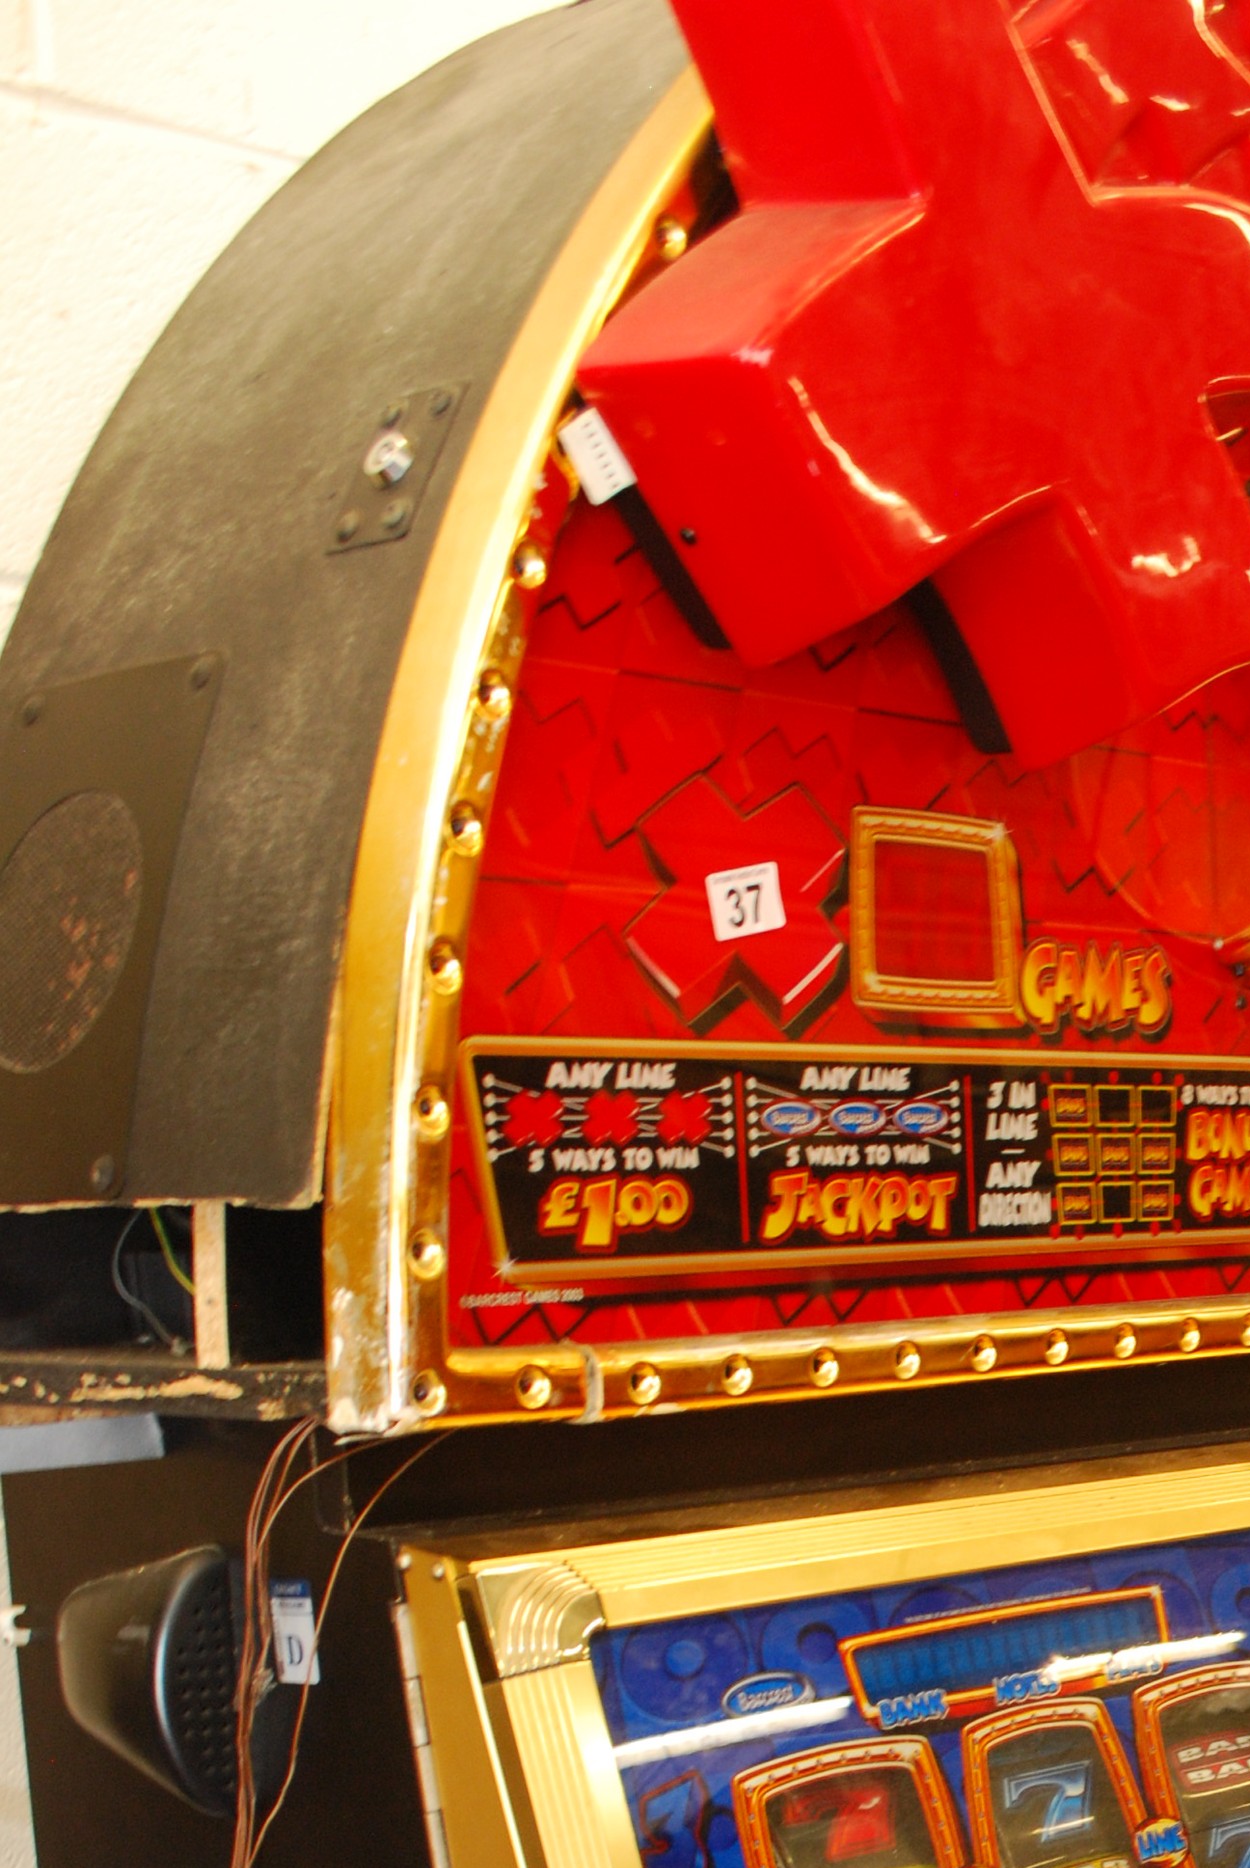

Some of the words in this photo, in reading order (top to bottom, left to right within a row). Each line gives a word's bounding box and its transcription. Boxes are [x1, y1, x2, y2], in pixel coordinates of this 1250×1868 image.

[727, 884, 761, 927] 37
[1024, 942, 1170, 1028] GAMES
[546, 1062, 609, 1088] ANY
[615, 1063, 677, 1089] LINE
[801, 1067, 853, 1091] ANY
[858, 1067, 911, 1091] LINE
[987, 1081, 1005, 1109] 3
[985, 1113, 1038, 1141] LINE
[529, 1149, 543, 1173] 5
[552, 1148, 616, 1172] WAYS
[621, 1147, 655, 1170] TO
[659, 1146, 700, 1170] WIN
[786, 1145, 800, 1167] 5
[805, 1145, 860, 1166] WAYS
[864, 1144, 891, 1166] TO
[893, 1144, 931, 1165] WIN
[986, 1161, 1041, 1188] ANY
[541, 1175, 691, 1248] £1.00
[287, 1633, 304, 1665] D
[880, 1690, 948, 1727] BANK
[1004, 1761, 1093, 1844] 7
[781, 1789, 896, 1863] 7
[1138, 1823, 1187, 1864] LINE
